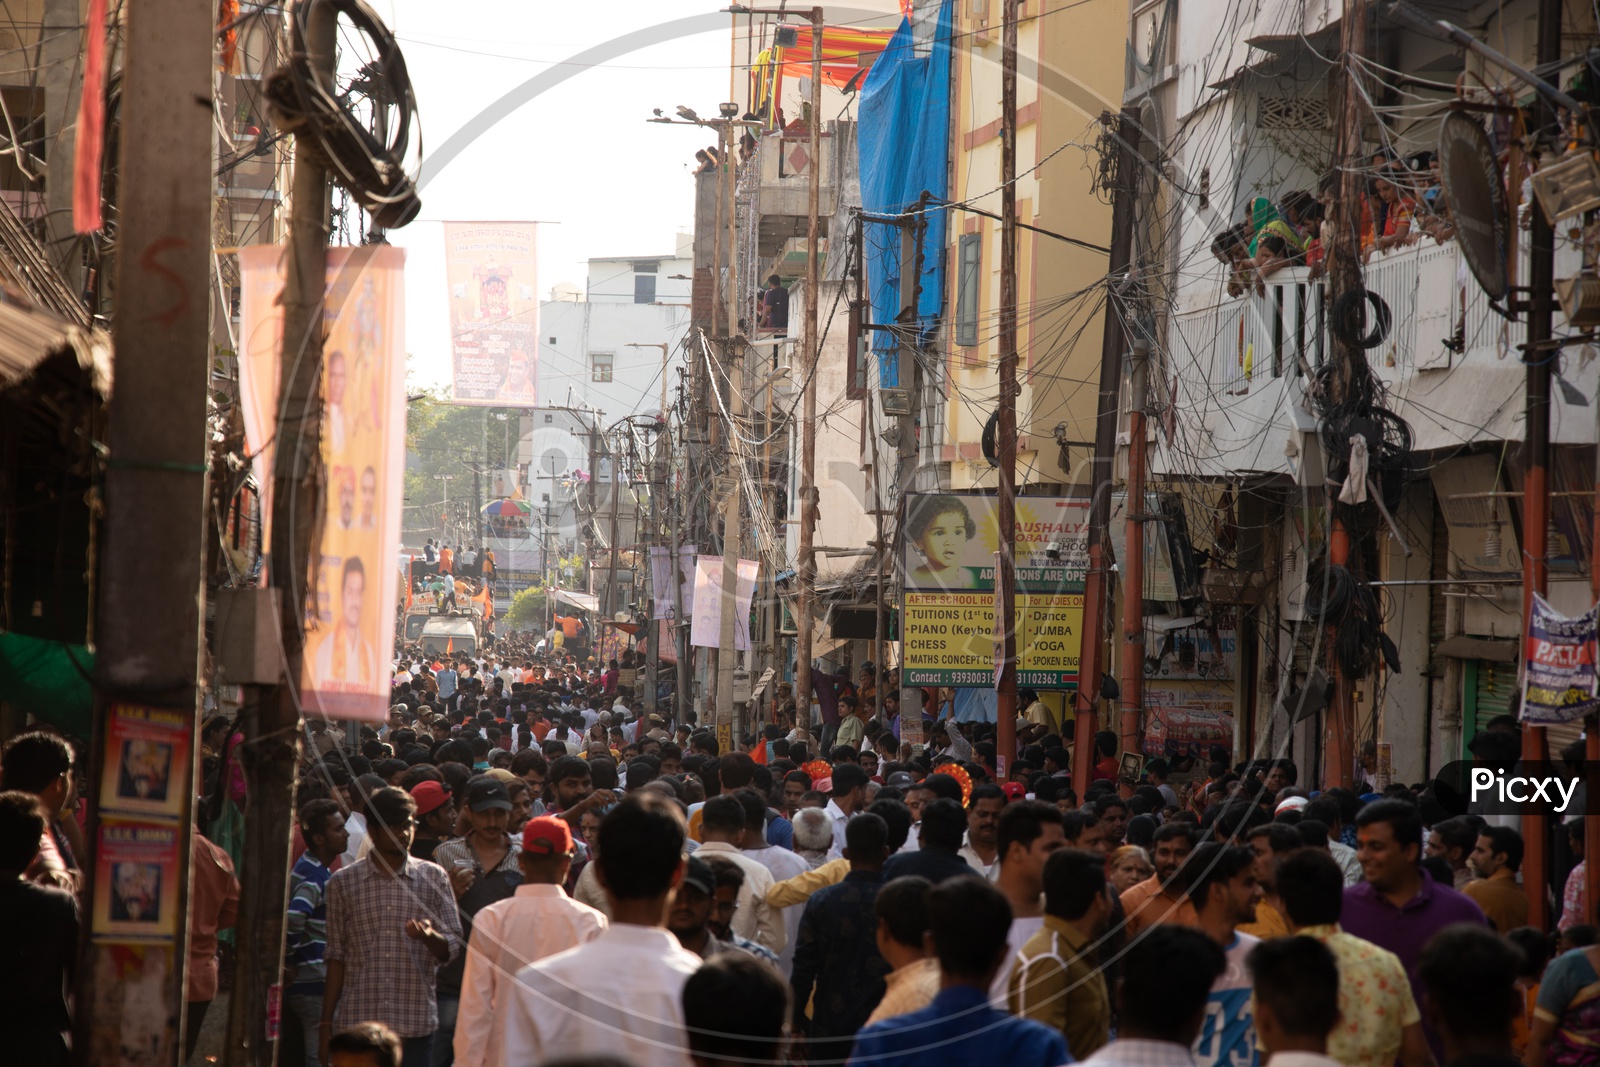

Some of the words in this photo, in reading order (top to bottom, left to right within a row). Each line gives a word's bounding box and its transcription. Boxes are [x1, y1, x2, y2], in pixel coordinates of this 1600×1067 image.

[1015, 522, 1089, 533] AUSHALYA
[1015, 533, 1050, 543] OBAL
[1043, 570, 1064, 581] ARE
[1066, 570, 1086, 582] OPE
[908, 595, 937, 604] AFTER
[939, 595, 978, 605] SCHOOL
[1029, 596, 1042, 606] For
[1045, 597, 1071, 606] LADIES
[1072, 597, 1084, 606] ON
[911, 609, 960, 620] TUITIONS
[983, 612, 994, 620] to
[1033, 611, 1067, 621] Dance
[910, 624, 948, 635] PIANO
[1033, 626, 1072, 636] JUMBA
[910, 639, 947, 650] CHESS
[1033, 641, 1065, 651] YOGA
[910, 654, 939, 665] MATHS
[941, 654, 980, 665] CONCEPT
[1032, 656, 1061, 666] SPOKEN
[910, 671, 942, 683] Contact
